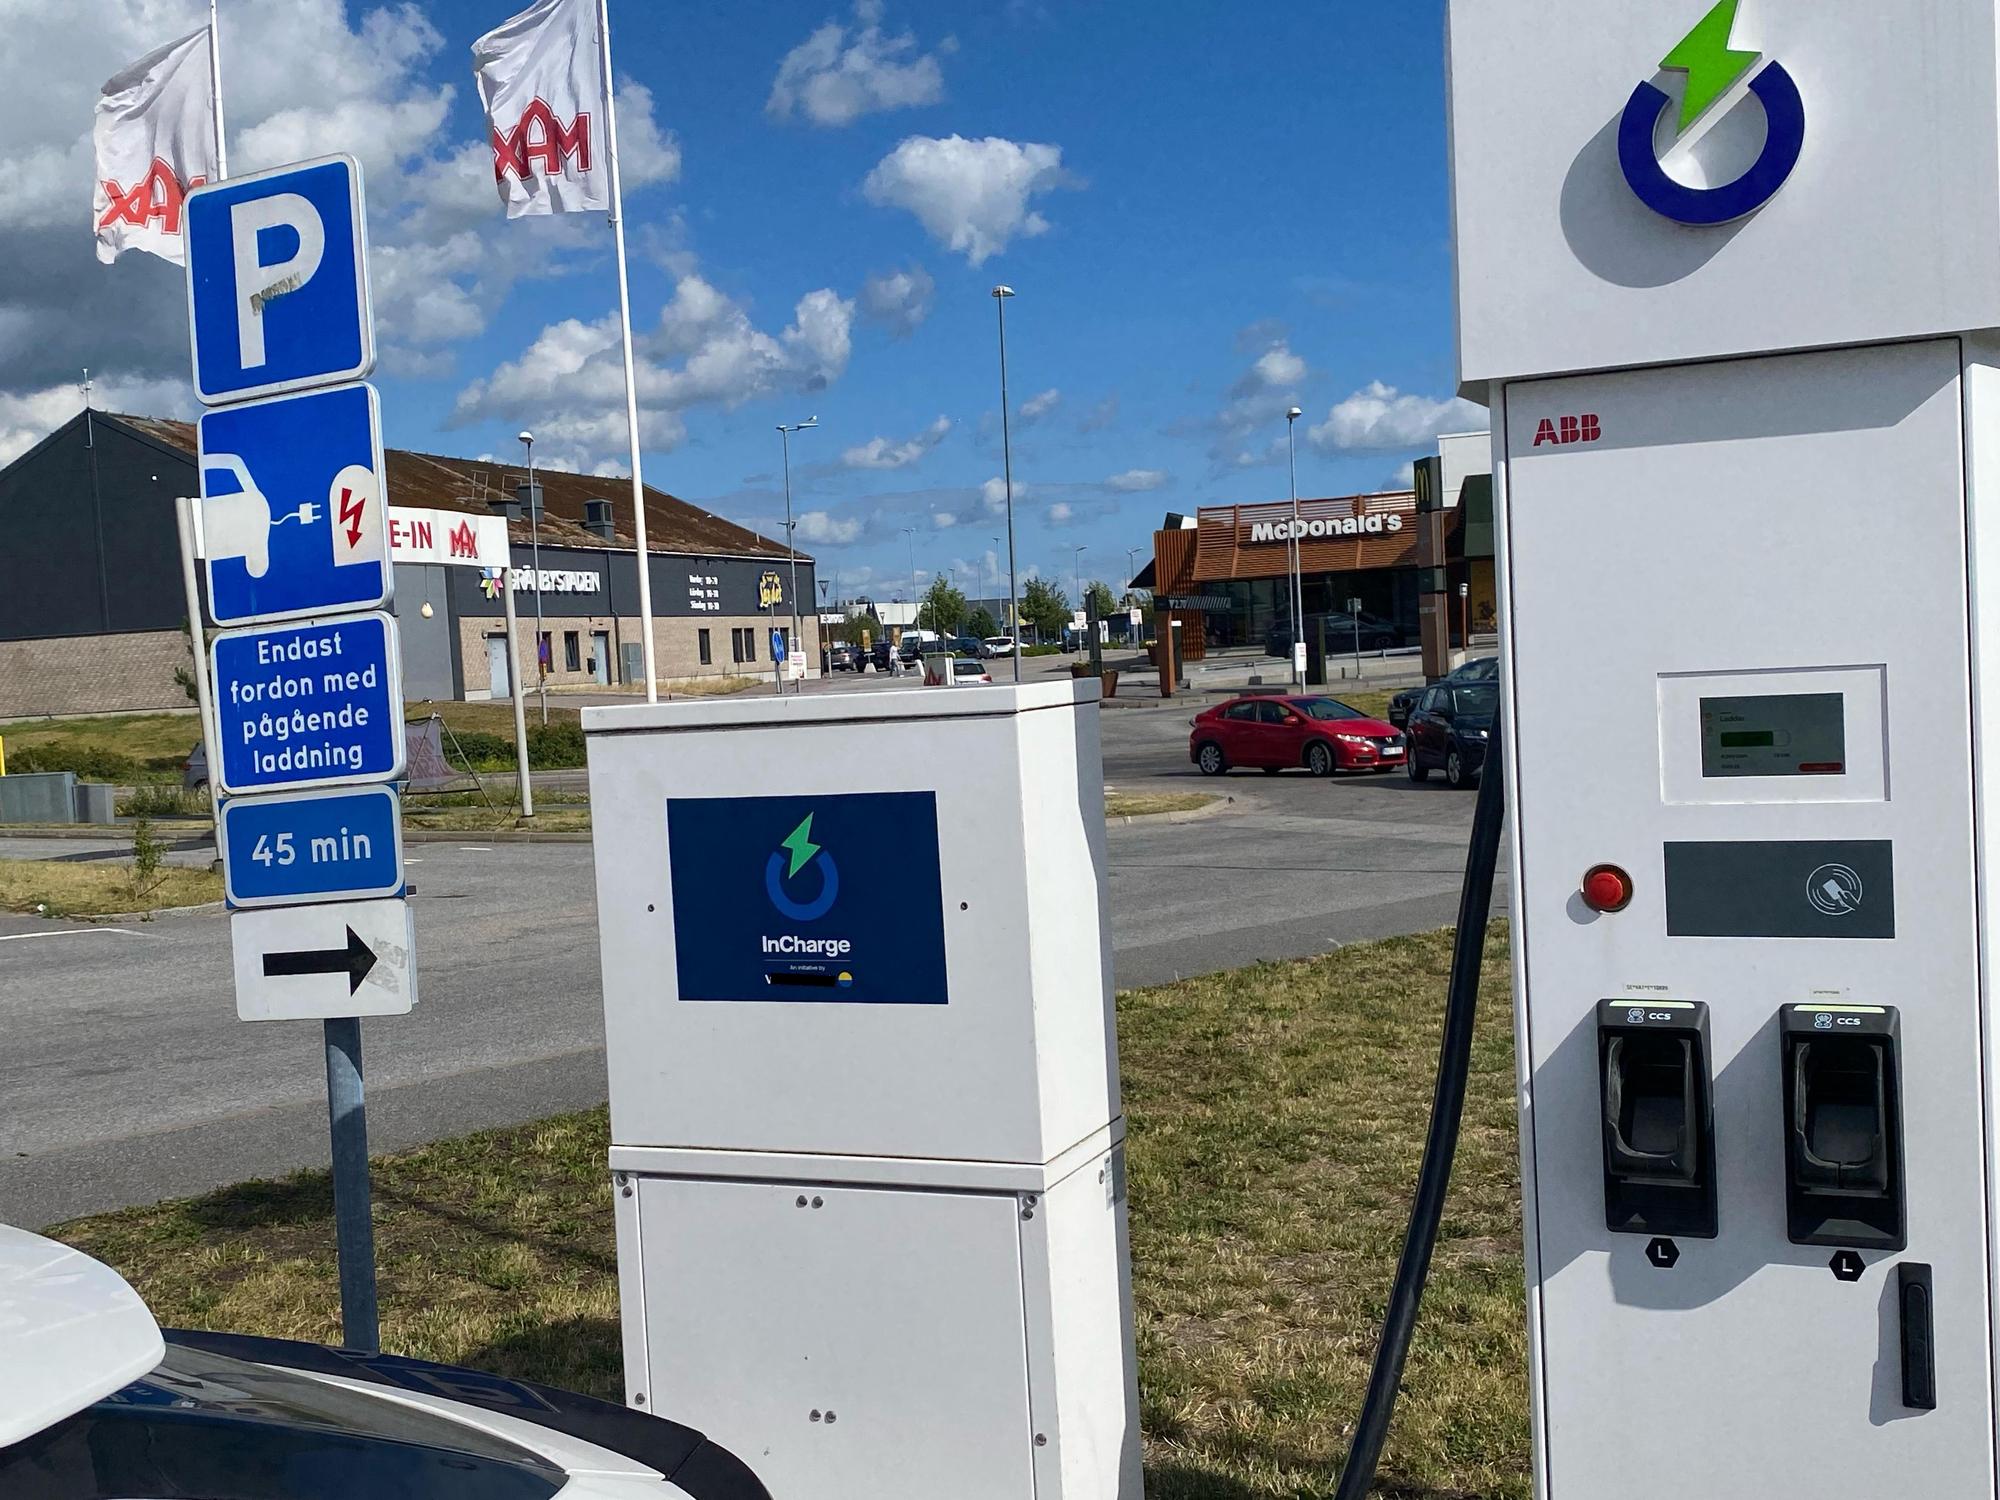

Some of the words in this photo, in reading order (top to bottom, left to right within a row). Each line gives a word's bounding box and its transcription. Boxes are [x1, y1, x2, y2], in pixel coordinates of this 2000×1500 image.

[231, 192, 325, 370] P
[1533, 414, 1601, 446] ABB
[448, 519, 479, 559] MAX
[1251, 513, 1403, 542] McDonald's
[258, 631, 343, 665] Endast
[230, 675, 314, 704] fordon
[323, 664, 377, 694] med
[243, 703, 369, 744] pågående
[254, 742, 363, 774] laddning
[252, 832, 296, 867] 45
[311, 827, 372, 863] min
[762, 935, 851, 957] InCharge
[1648, 1011, 1671, 1021] CCS
[1837, 1016, 1861, 1026] CCS
[1657, 1245, 1668, 1259] L
[1842, 1258, 1853, 1273] L
